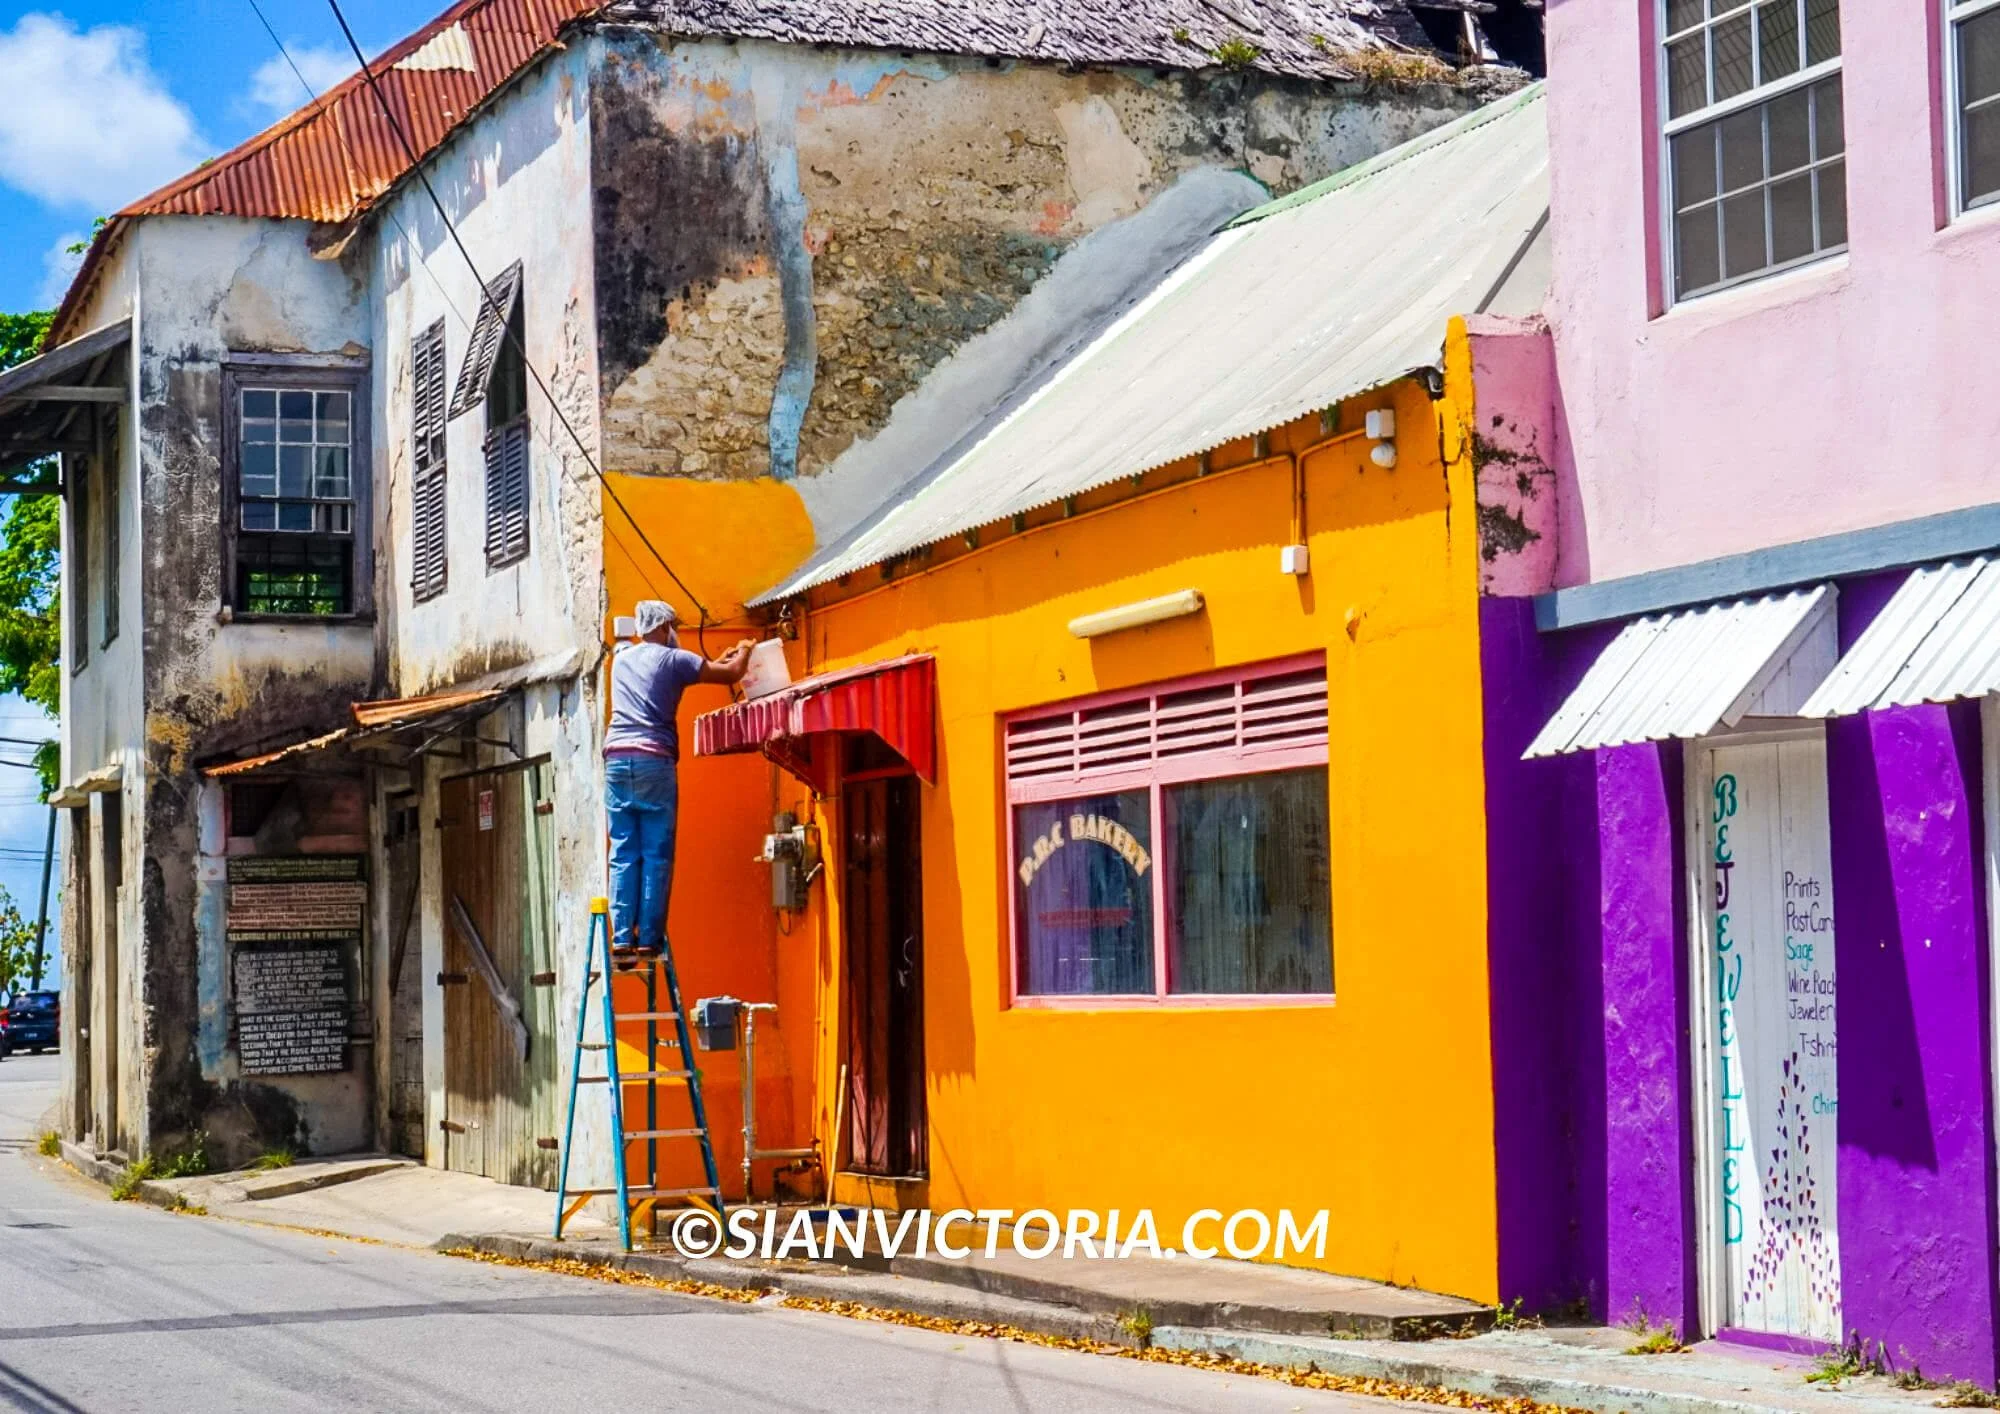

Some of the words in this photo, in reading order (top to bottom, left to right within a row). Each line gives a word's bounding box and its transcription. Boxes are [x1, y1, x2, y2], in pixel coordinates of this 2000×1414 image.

[1070, 814, 1151, 877] BAKERY
[1785, 870, 1820, 898] Prints
[1786, 935, 1814, 972] Sage
[1788, 968, 1810, 994] Wine
[332, 1019, 347, 1027] THAT
[1713, 774, 1744, 1244] BEJEWELLED
[262, 1049, 279, 1057] THAT
[291, 1047, 309, 1055] ROSE
